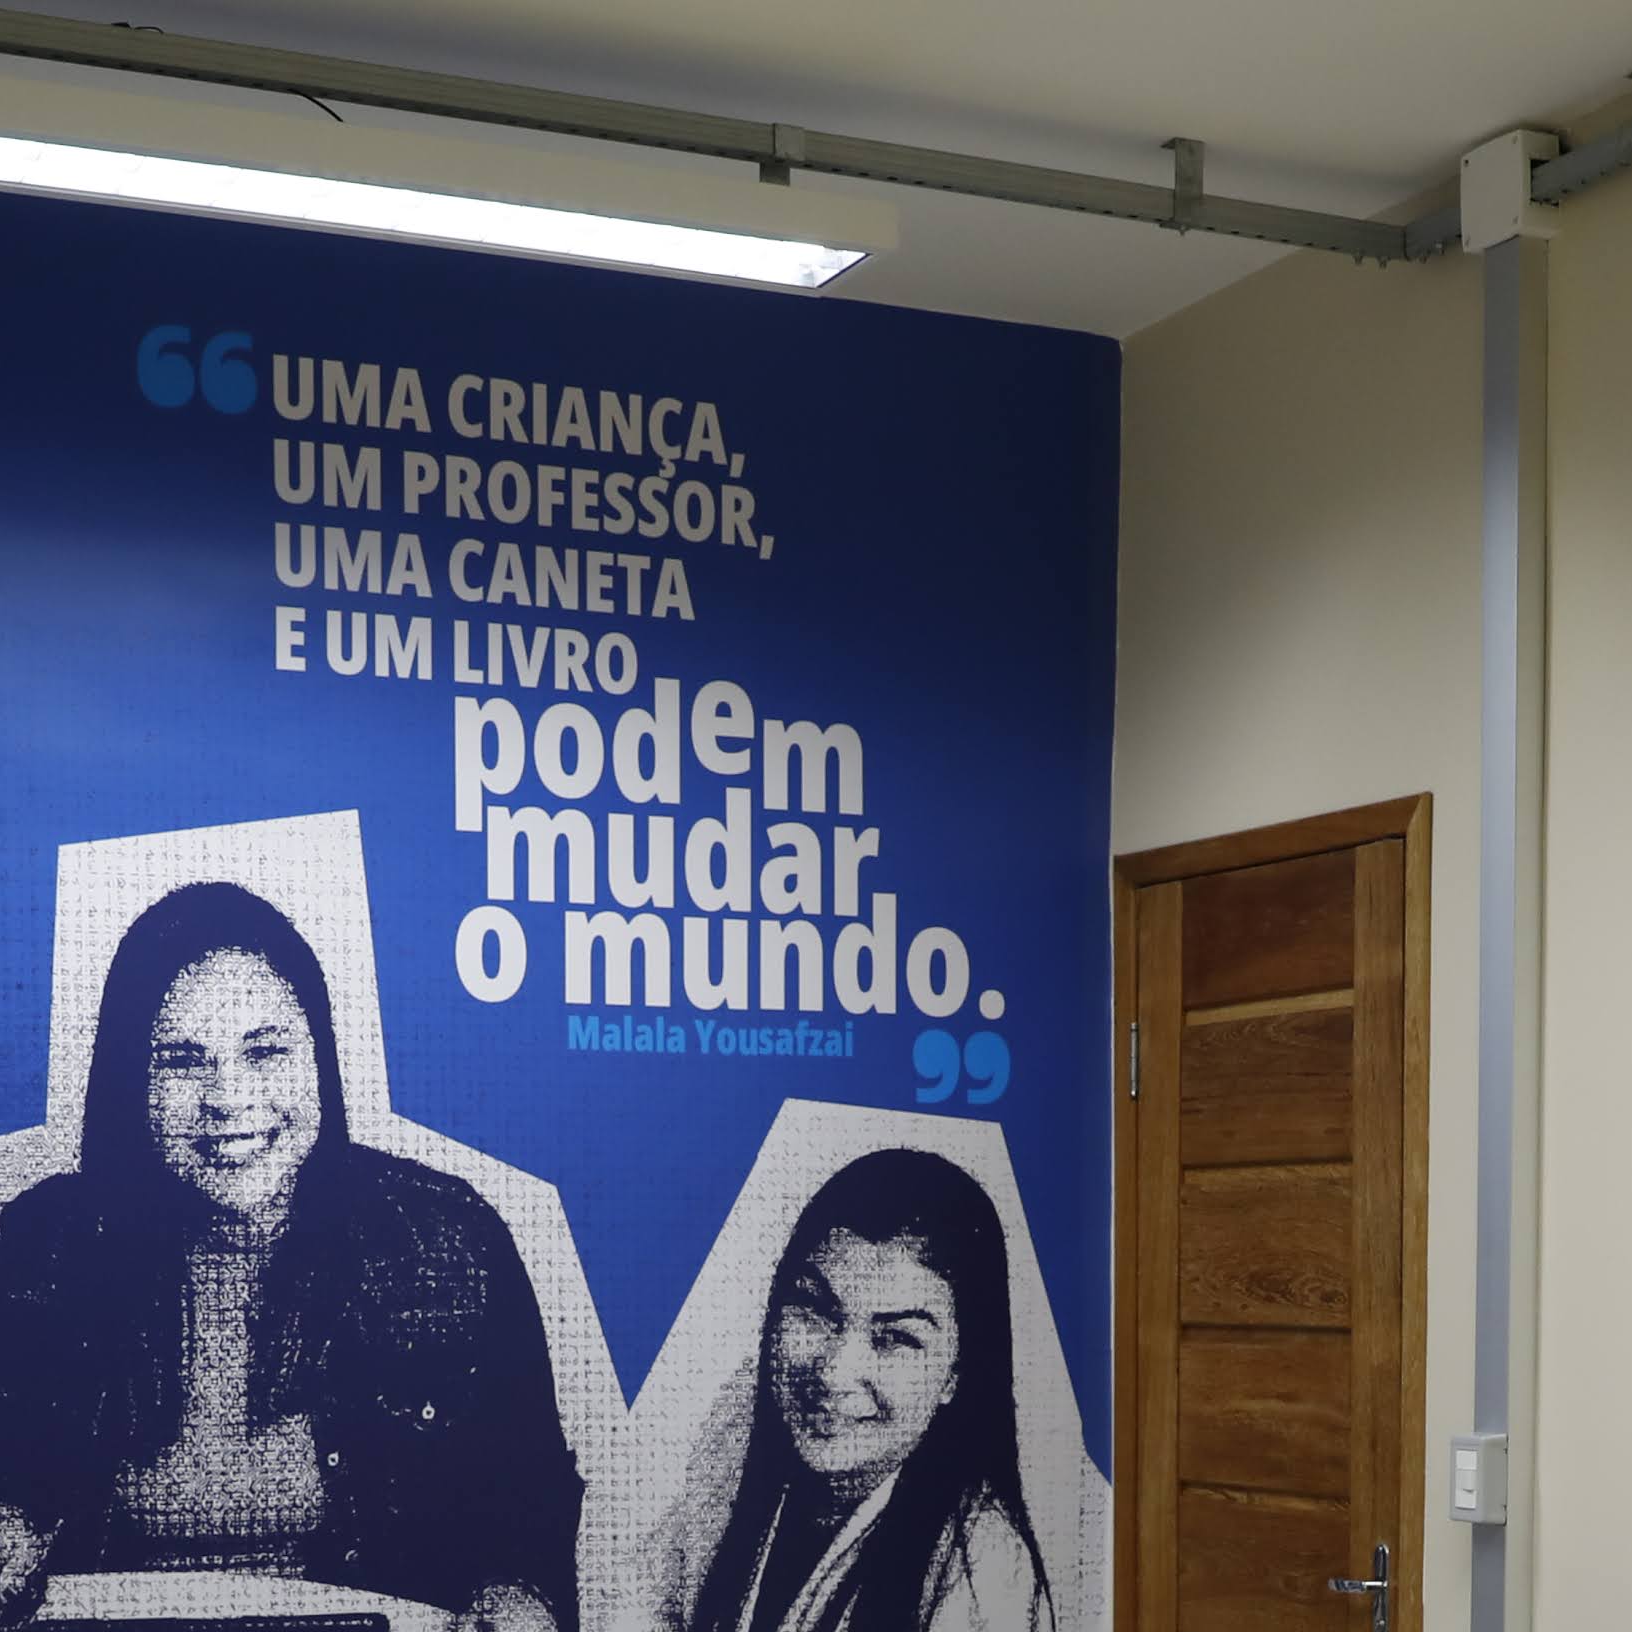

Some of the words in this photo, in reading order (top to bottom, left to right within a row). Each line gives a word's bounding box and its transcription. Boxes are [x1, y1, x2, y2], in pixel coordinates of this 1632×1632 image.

[273, 354, 432, 433] UMA
[448, 374, 746, 479] CRIANÇA,
[274, 439, 382, 511] UM
[404, 452, 775, 561] PROFESSOR,
[275, 523, 433, 598] UMA
[449, 539, 696, 621] CANETA
[275, 606, 307, 673] E
[327, 610, 433, 681] UM
[454, 620, 638, 695] LIVRO
[454, 677, 864, 833] podem
[487, 788, 880, 917] mudar
[455, 905, 528, 1004] o
[565, 892, 1006, 1021] mundo.
[567, 1014, 686, 1054] Malala
[695, 1018, 855, 1057] Yousafzai
